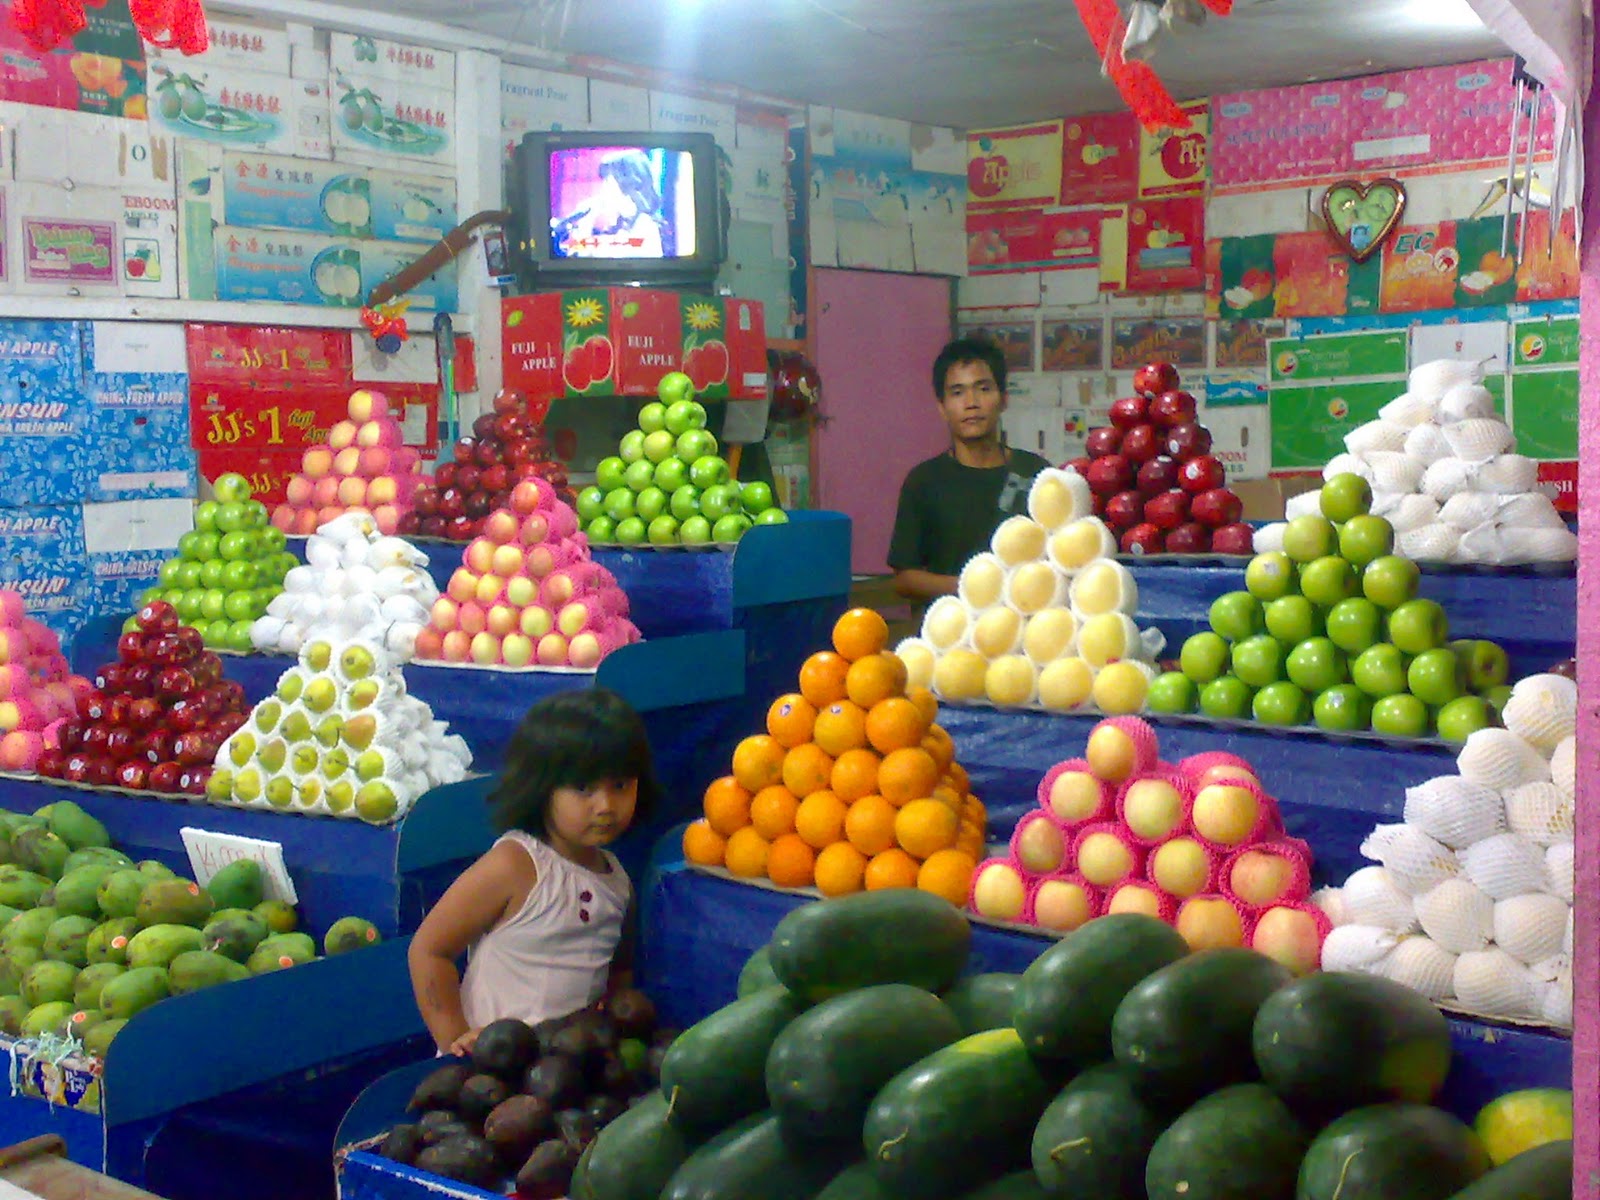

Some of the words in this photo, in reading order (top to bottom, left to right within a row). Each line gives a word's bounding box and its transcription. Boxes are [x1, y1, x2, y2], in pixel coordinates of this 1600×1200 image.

[12, 341, 59, 356] APPLE
[511, 341, 536, 355] FUJI
[628, 335, 653, 348] FUJI
[521, 356, 557, 371] APPLE
[639, 353, 675, 366] APPLE
[12, 516, 60, 531] APPLE
